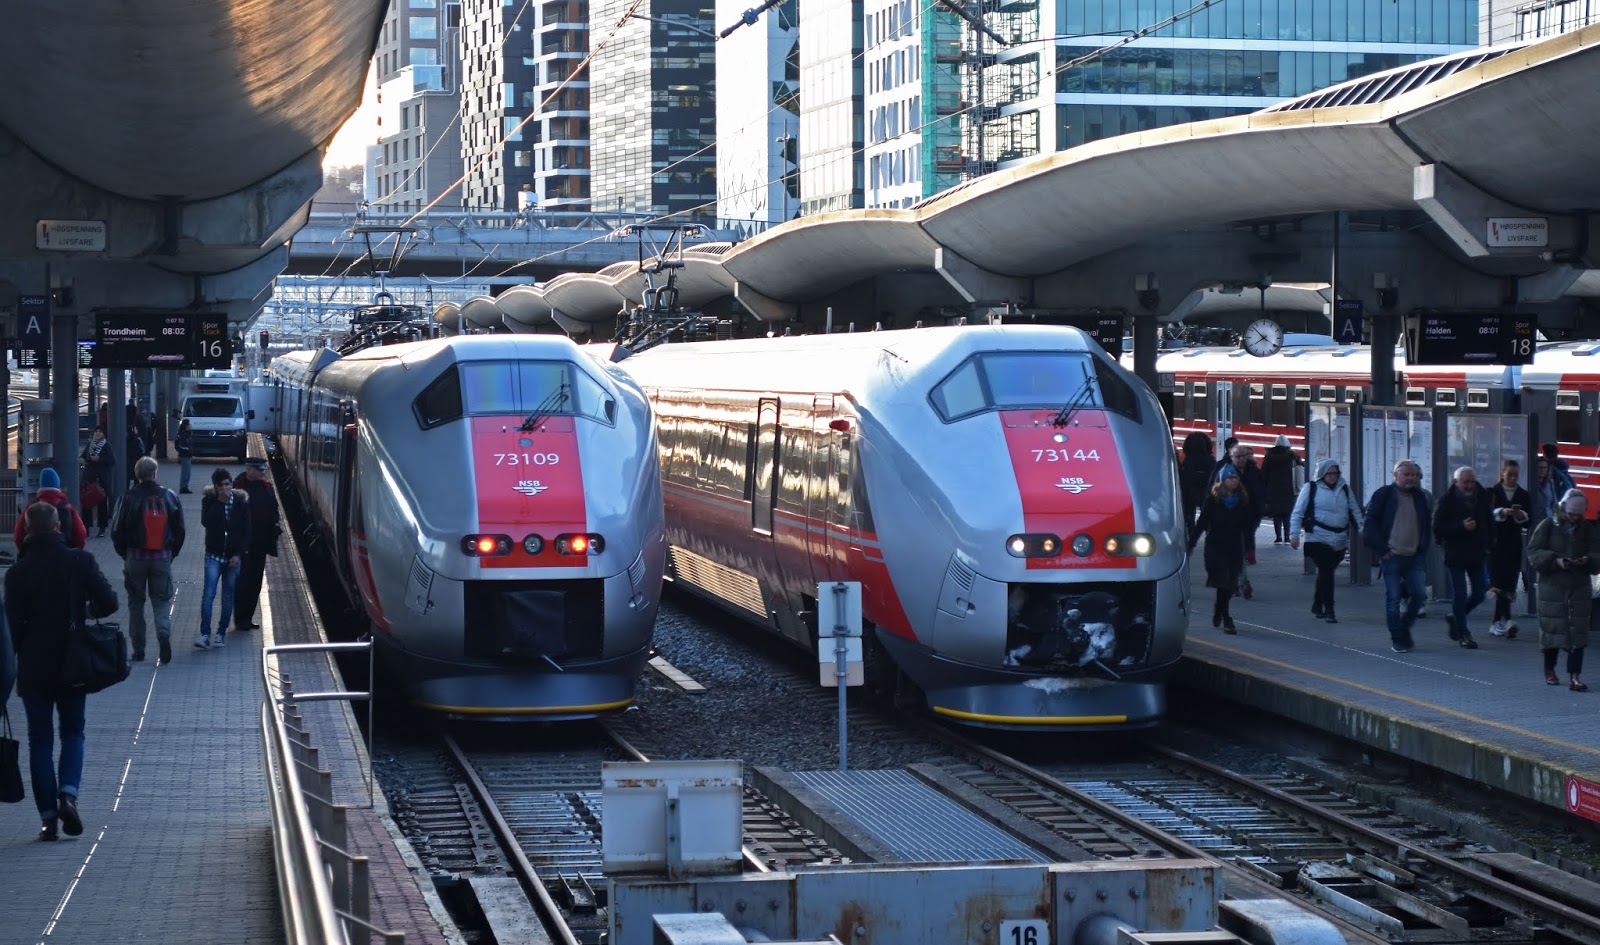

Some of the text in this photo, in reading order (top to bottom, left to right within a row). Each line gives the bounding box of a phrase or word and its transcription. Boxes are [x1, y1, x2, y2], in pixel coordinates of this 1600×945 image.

[51, 225, 102, 233] HØGSPENNING
[58, 238, 94, 246] LIVSFARE
[1339, 301, 1360, 309] Sektor
[25, 315, 42, 334] A
[202, 321, 218, 329] Spor
[1342, 318, 1356, 336] A
[1515, 321, 1530, 329] Spor
[103, 327, 146, 336] Trondheim
[162, 327, 185, 336] 08:02
[203, 328, 220, 336] Track
[1425, 327, 1452, 335] Halden
[1478, 326, 1499, 335] 08:01
[200, 339, 222, 358] 16
[1510, 338, 1531, 356] 18
[493, 453, 560, 466] 73109
[1031, 449, 1101, 462] 73144
[1011, 925, 1038, 945] 16
